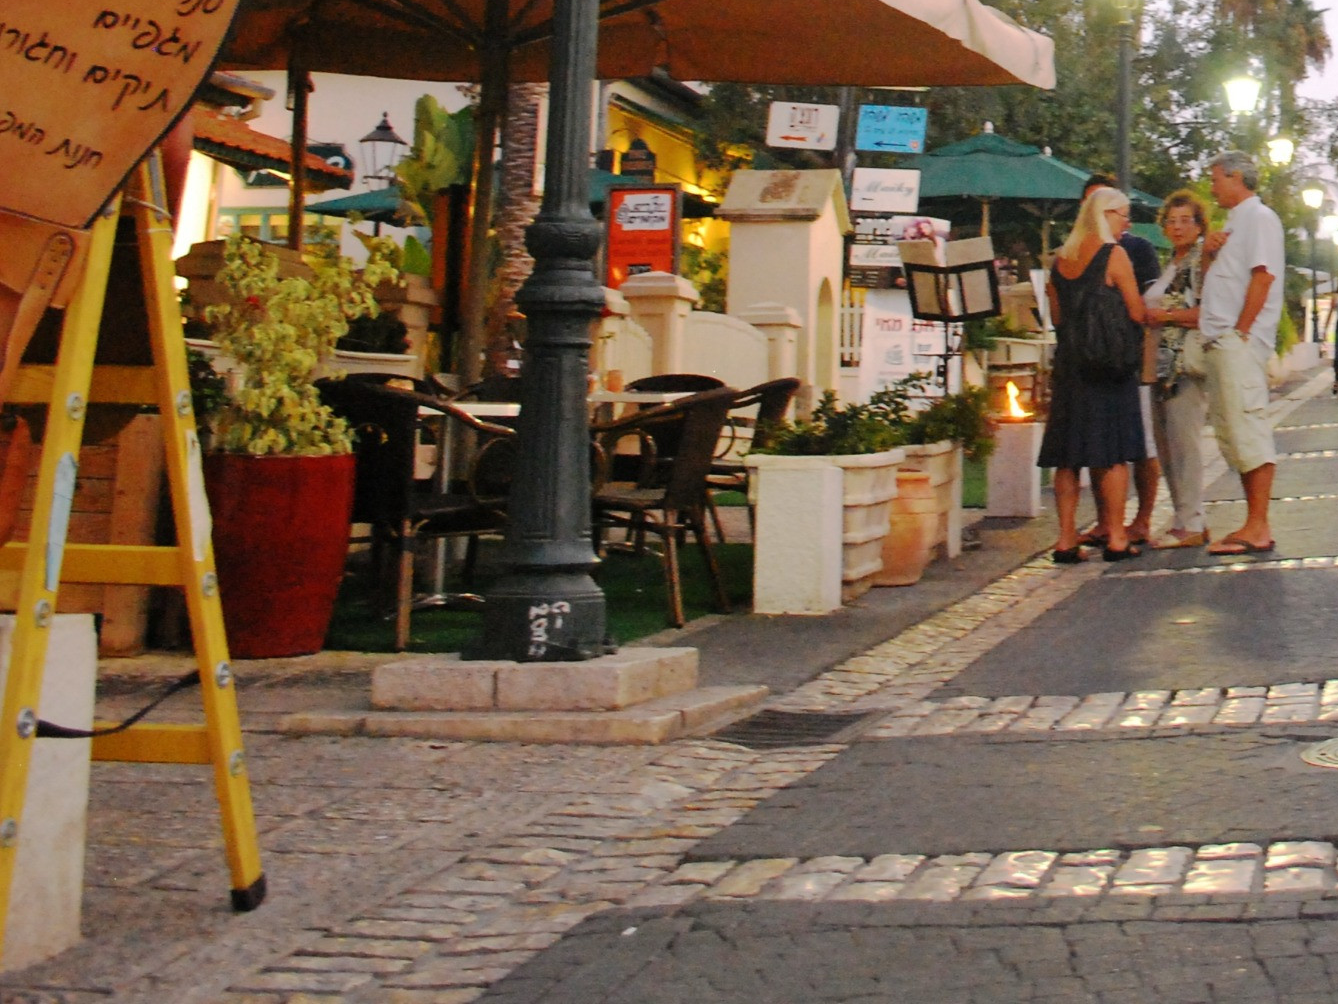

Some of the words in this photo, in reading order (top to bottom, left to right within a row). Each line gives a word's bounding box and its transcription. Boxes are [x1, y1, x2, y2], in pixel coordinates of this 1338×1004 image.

[93, 9, 203, 65] מגפיים
[82, 64, 170, 113] תיקים
[45, 138, 104, 170] חנות
